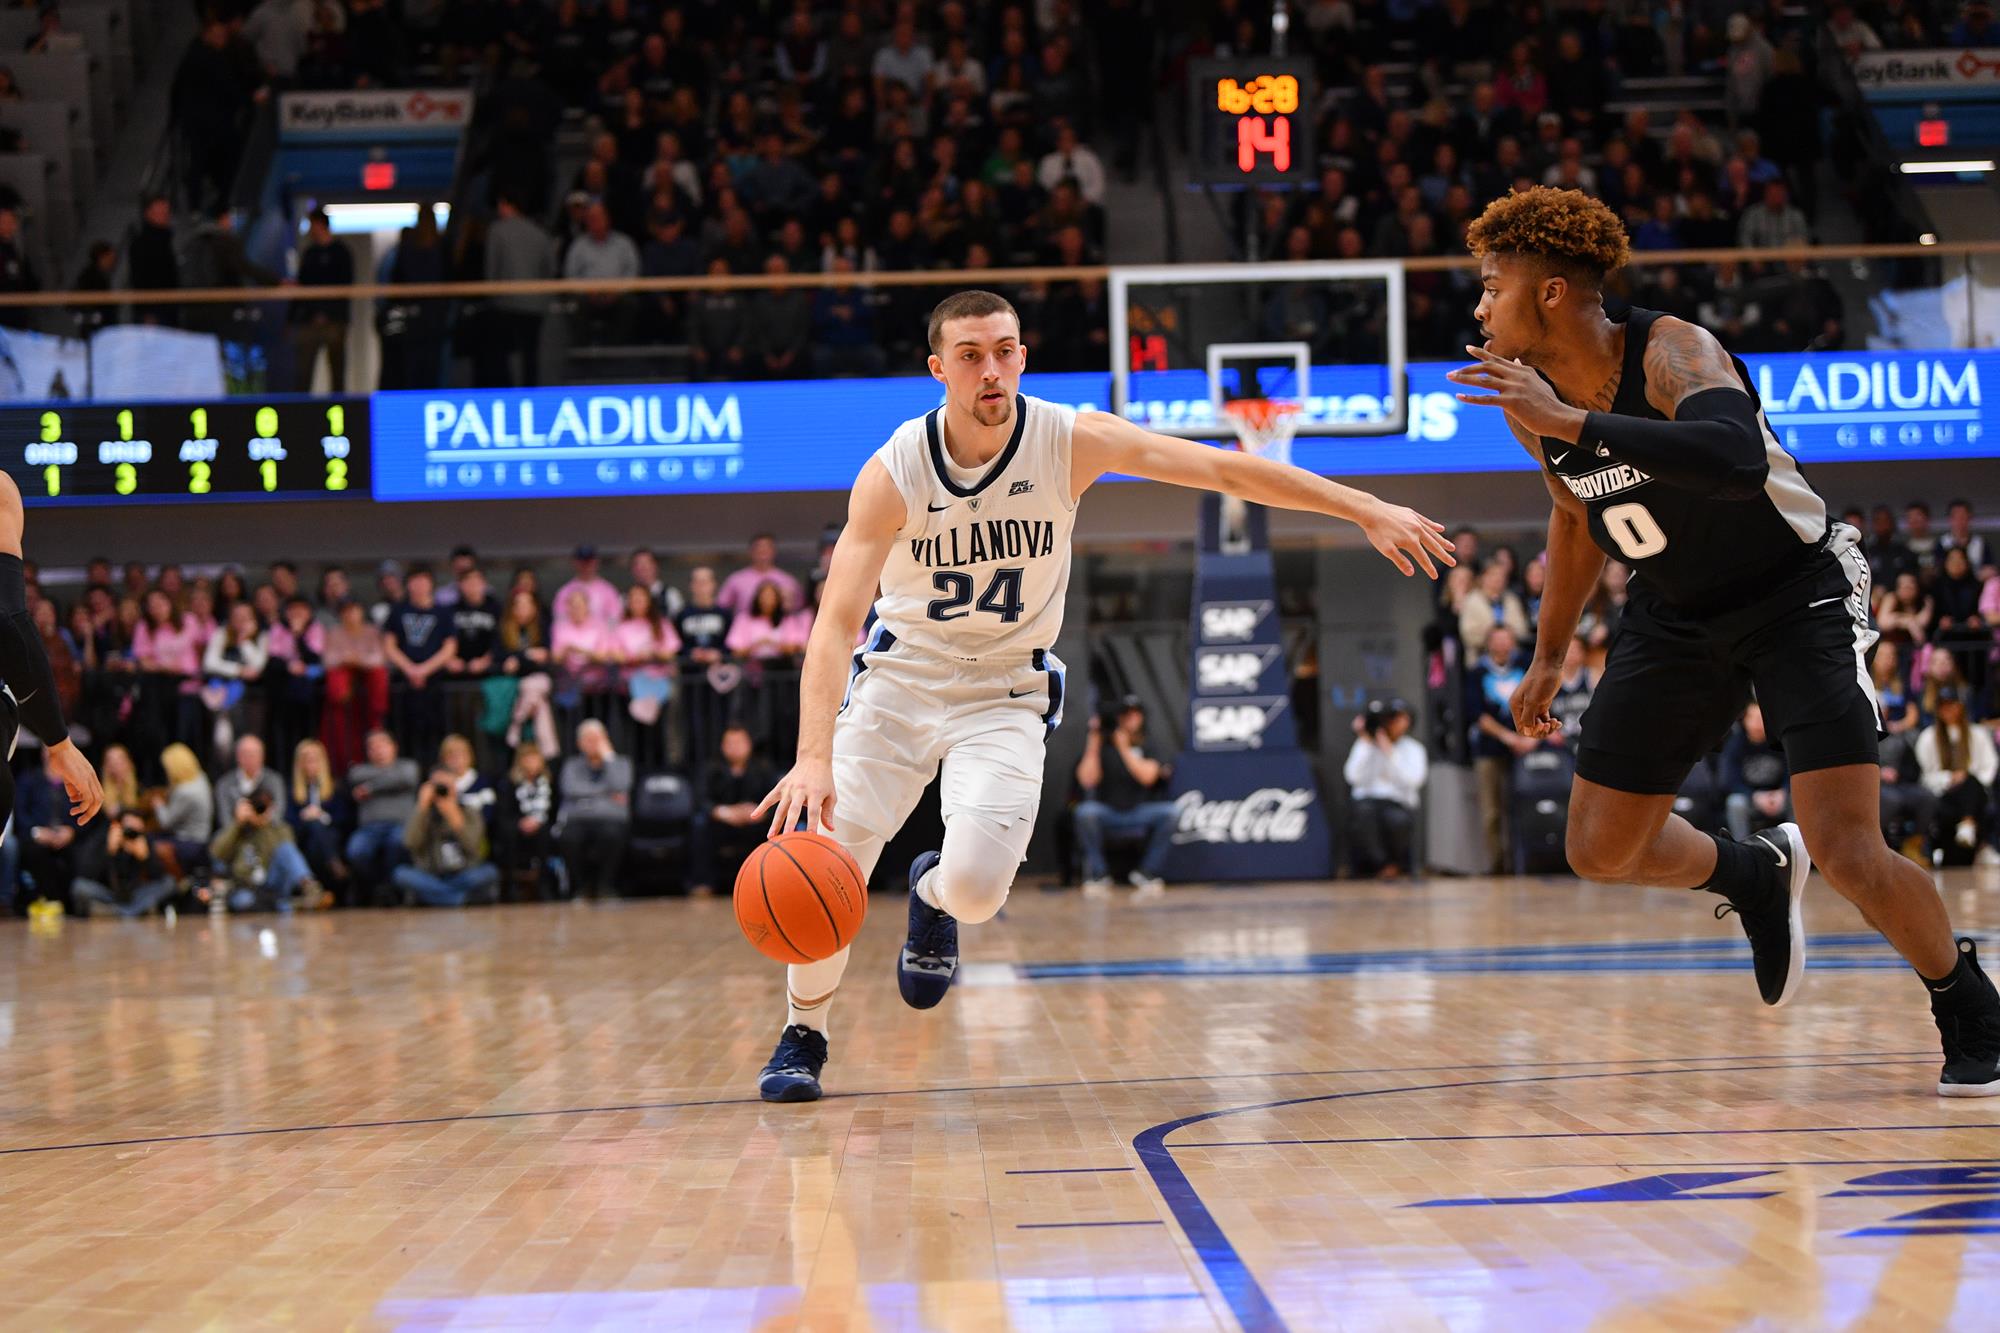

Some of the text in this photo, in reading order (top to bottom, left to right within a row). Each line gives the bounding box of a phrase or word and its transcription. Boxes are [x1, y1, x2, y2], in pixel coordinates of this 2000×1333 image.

[1238, 116, 1290, 173] 14
[1759, 359, 1982, 412] LADIUM
[116, 409, 133, 441] 1
[190, 407, 207, 439] 1
[326, 404, 344, 436] 1
[424, 394, 742, 449] PALLADIUM
[1836, 422, 1983, 448] GROUP
[43, 464, 60, 497] 1
[259, 459, 277, 492] 1
[425, 456, 744, 488] HOTEL GROUP
[1009, 485, 1034, 493] EAST
[1012, 480, 1029, 488] BIG
[912, 519, 1053, 567] VILLANOVA
[1602, 502, 1668, 559] 0
[927, 568, 1024, 623] 24
[1203, 608, 1256, 637] SAP
[1198, 653, 1261, 687] SAP
[1195, 705, 1266, 742] SAP
